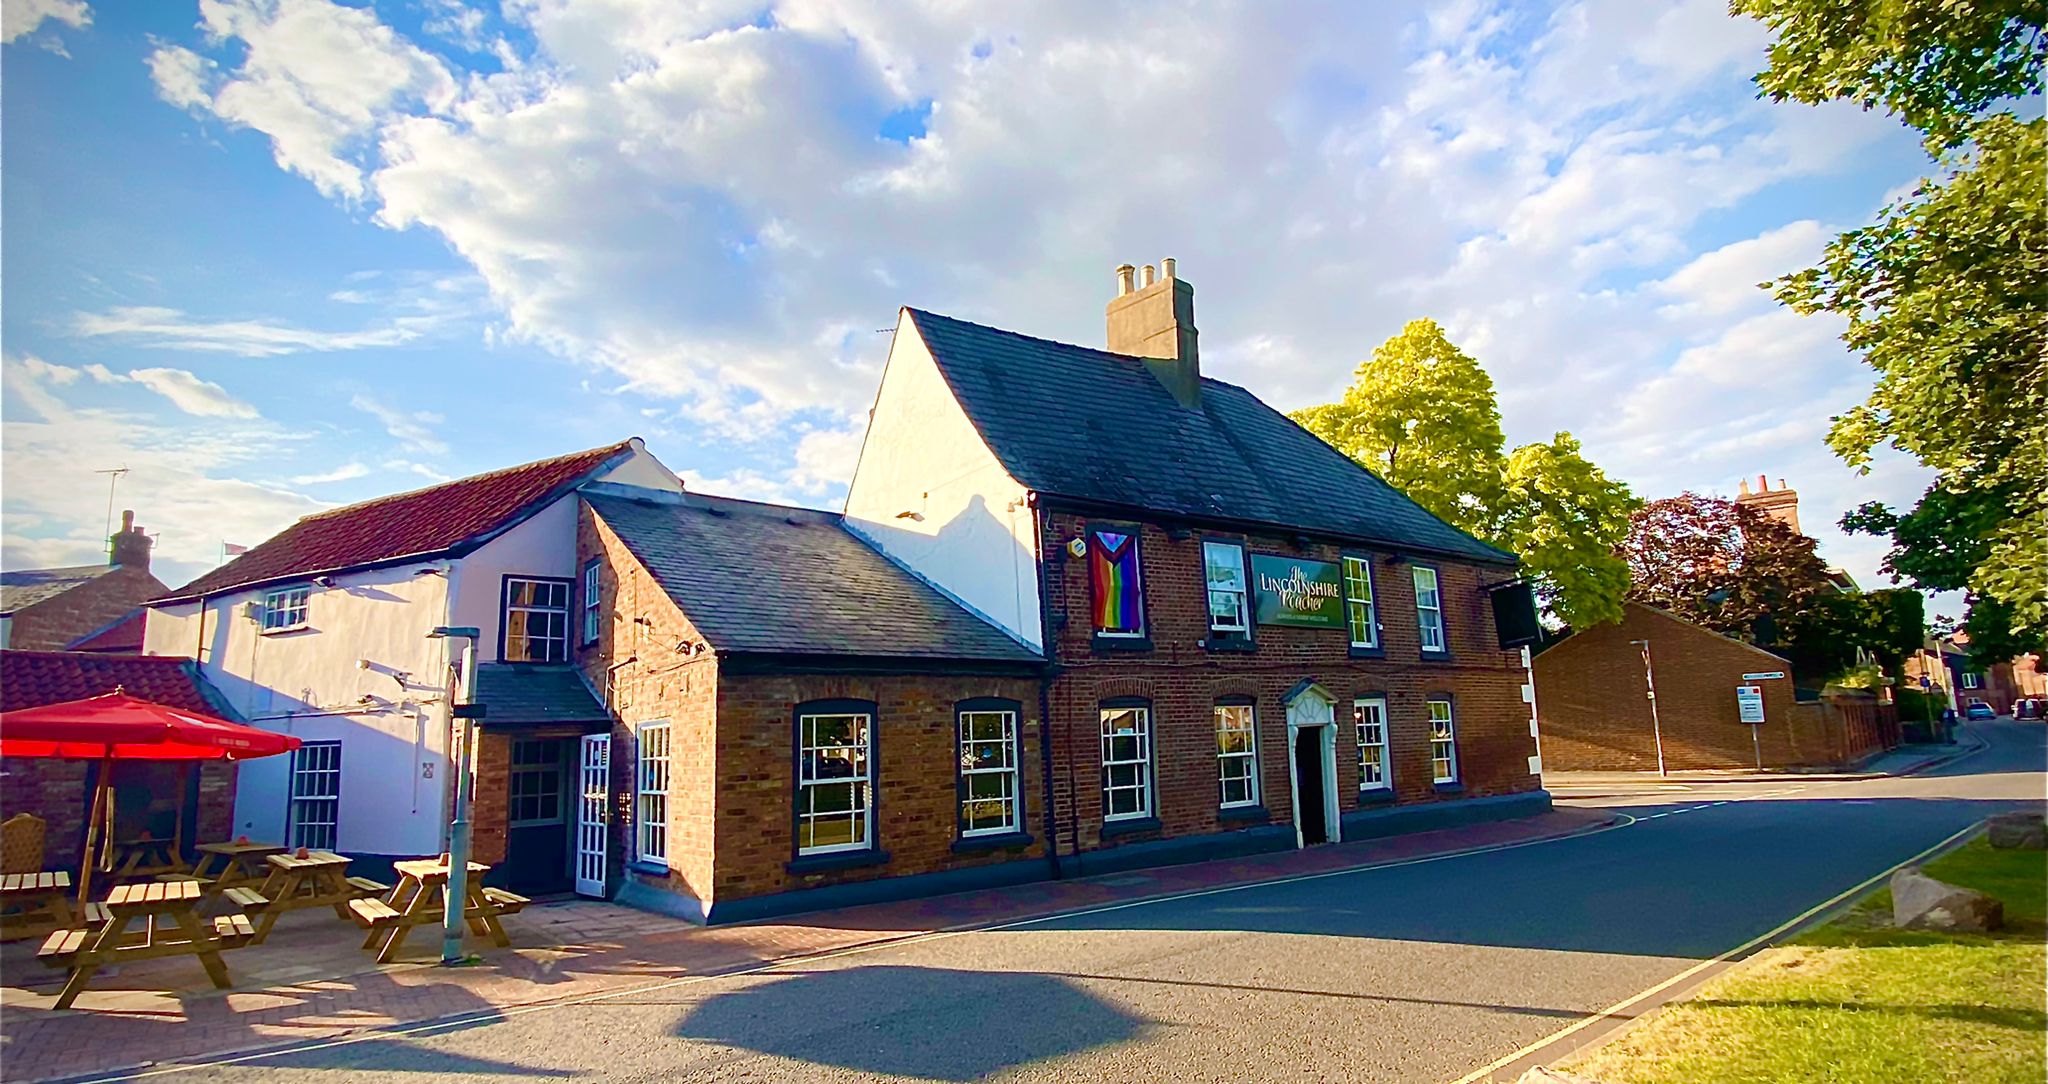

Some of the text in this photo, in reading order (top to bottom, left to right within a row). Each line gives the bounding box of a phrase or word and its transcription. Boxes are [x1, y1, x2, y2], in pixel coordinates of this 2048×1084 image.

[1290, 565, 1308, 581] The
[1261, 573, 1339, 597] LINCOLNSHIRE
[1279, 590, 1325, 611] Poacher
